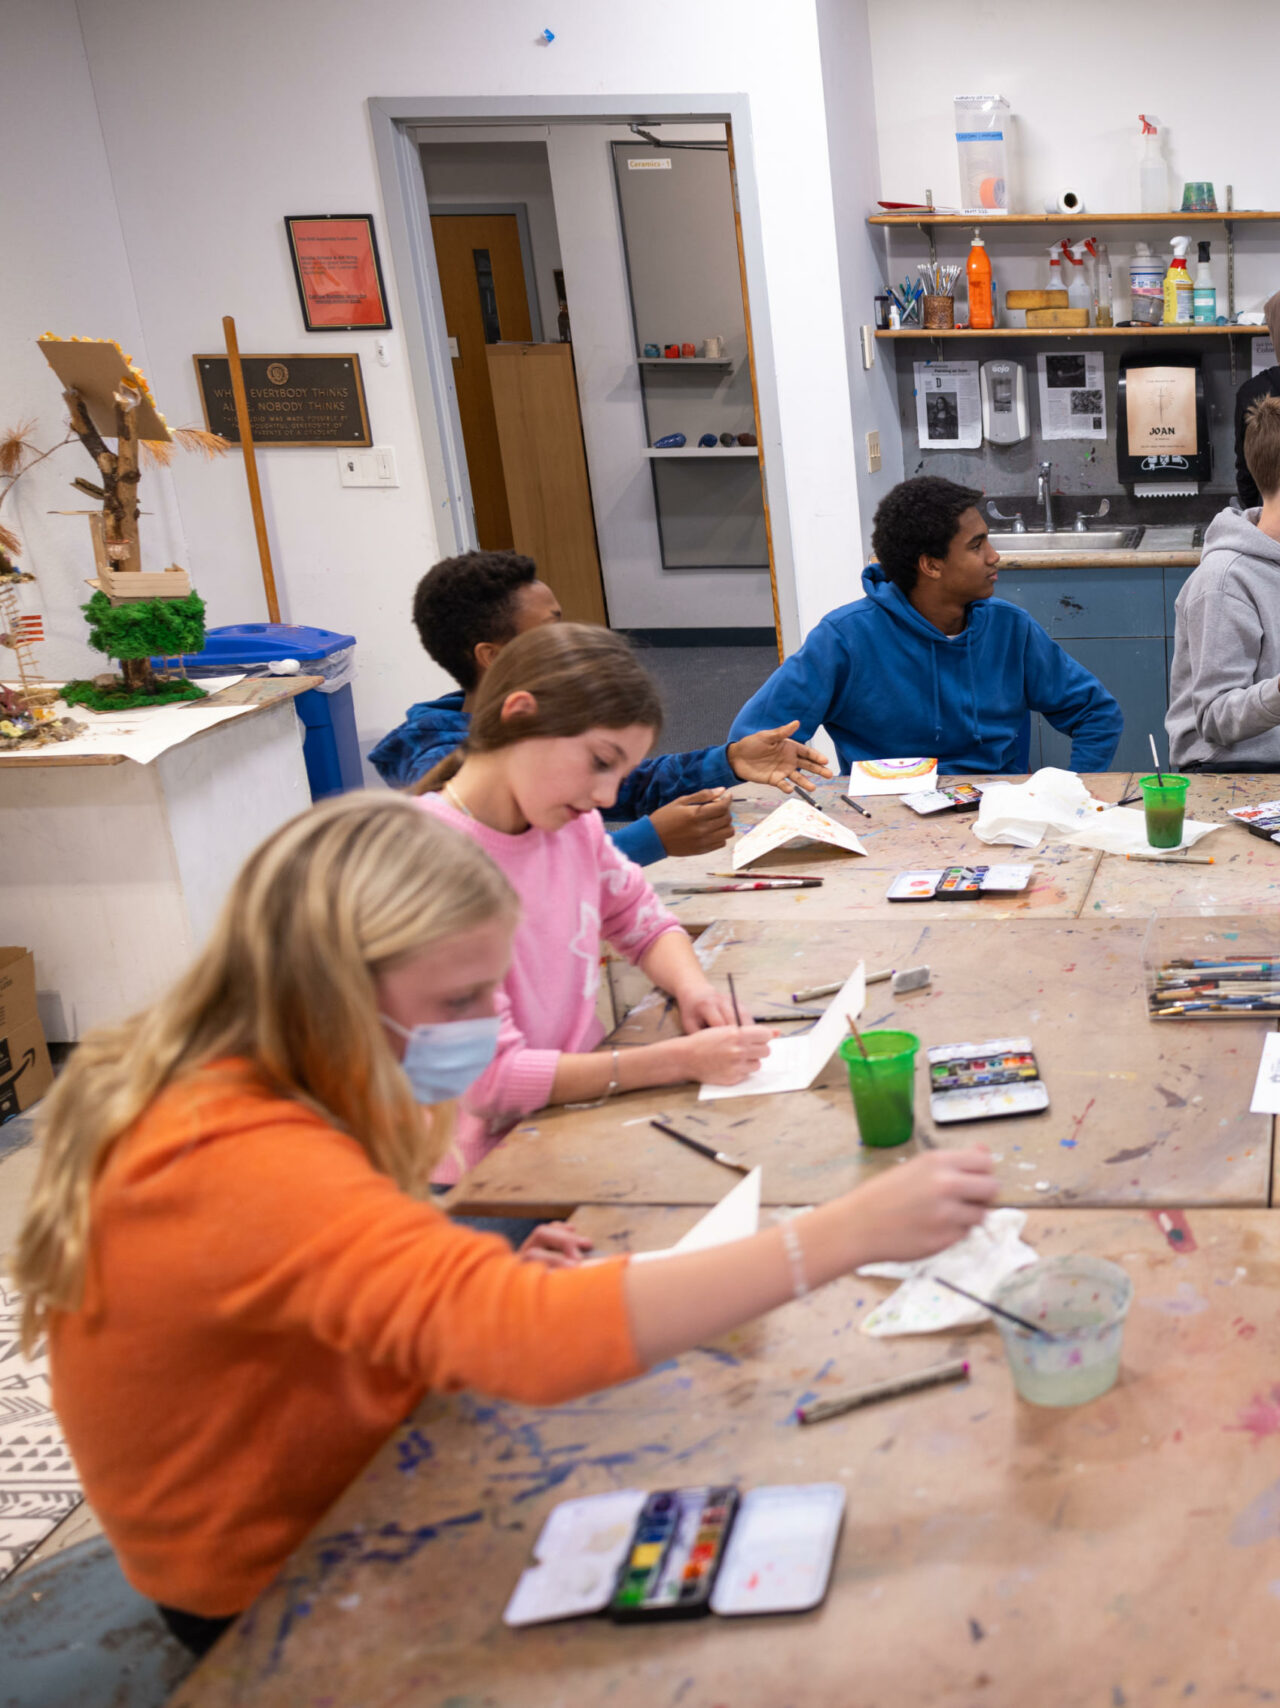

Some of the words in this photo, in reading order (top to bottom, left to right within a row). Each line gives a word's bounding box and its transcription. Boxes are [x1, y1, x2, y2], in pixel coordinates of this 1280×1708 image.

[629, 160, 661, 168] Ceramics
[251, 387, 308, 398] EVERYBODY
[312, 387, 348, 397] THINKS
[223, 402, 254, 412] ALE,
[258, 402, 303, 412] NOBODY
[308, 402, 345, 411] THINKS
[1149, 427, 1176, 436] JOAN
